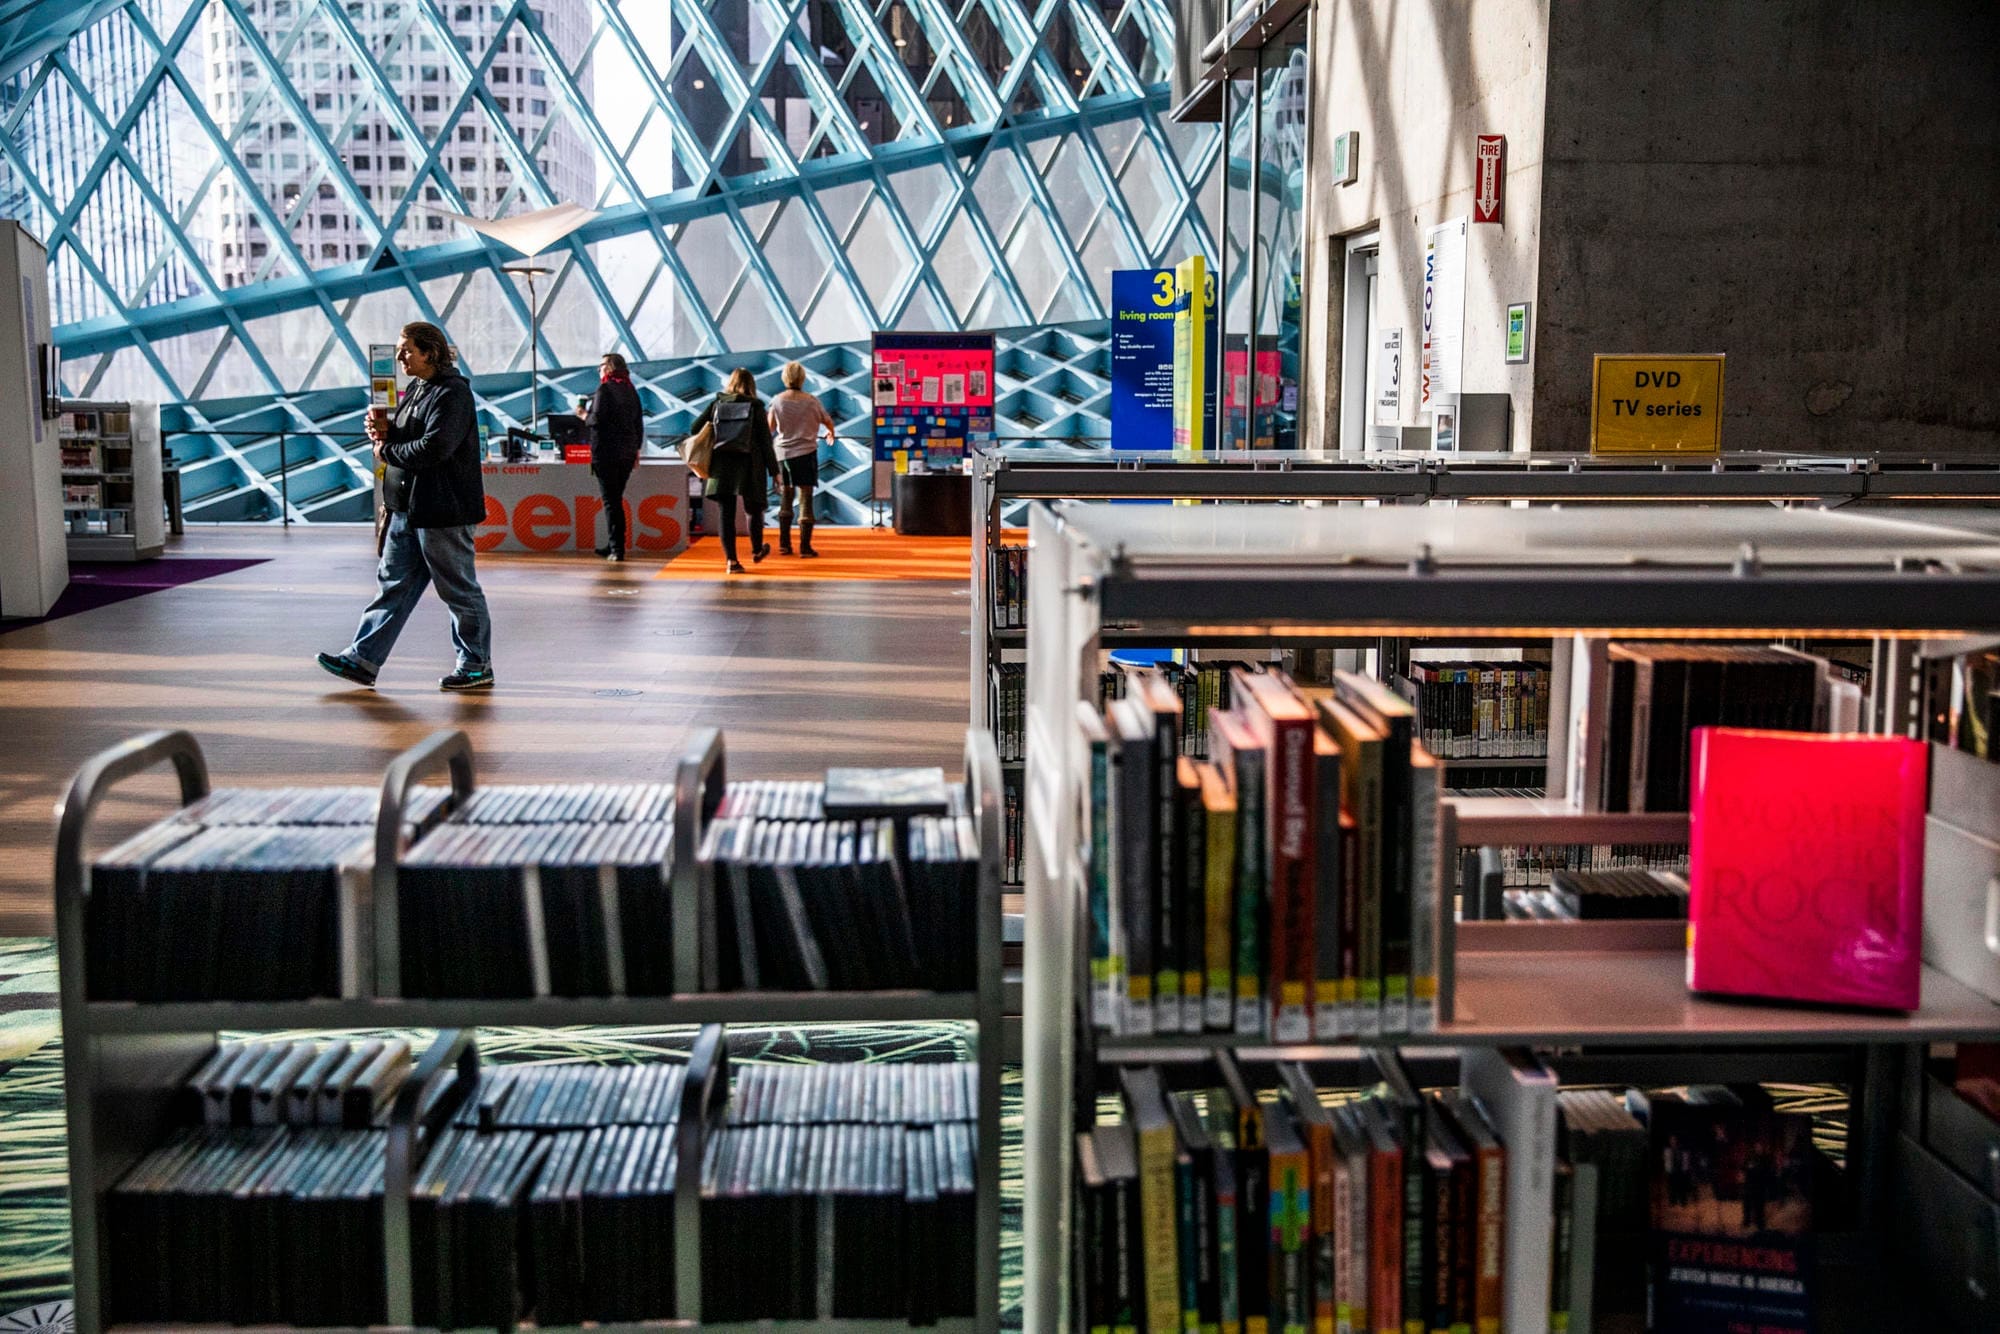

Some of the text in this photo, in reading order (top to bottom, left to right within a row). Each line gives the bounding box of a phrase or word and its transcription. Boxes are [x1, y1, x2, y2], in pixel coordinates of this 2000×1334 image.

[1481, 144, 1500, 156] FIRE
[1151, 271, 1175, 308] 3
[1119, 310, 1174, 323] living room
[1421, 233, 1436, 404] WELCOME
[1392, 353, 1399, 386] 3
[1634, 370, 1682, 389] DVD
[1612, 399, 1703, 417] TV series
[502, 465, 541, 475] center
[474, 493, 682, 552] eens
[1714, 791, 1899, 838] WOMEN
[1710, 866, 1901, 940] ROCK
